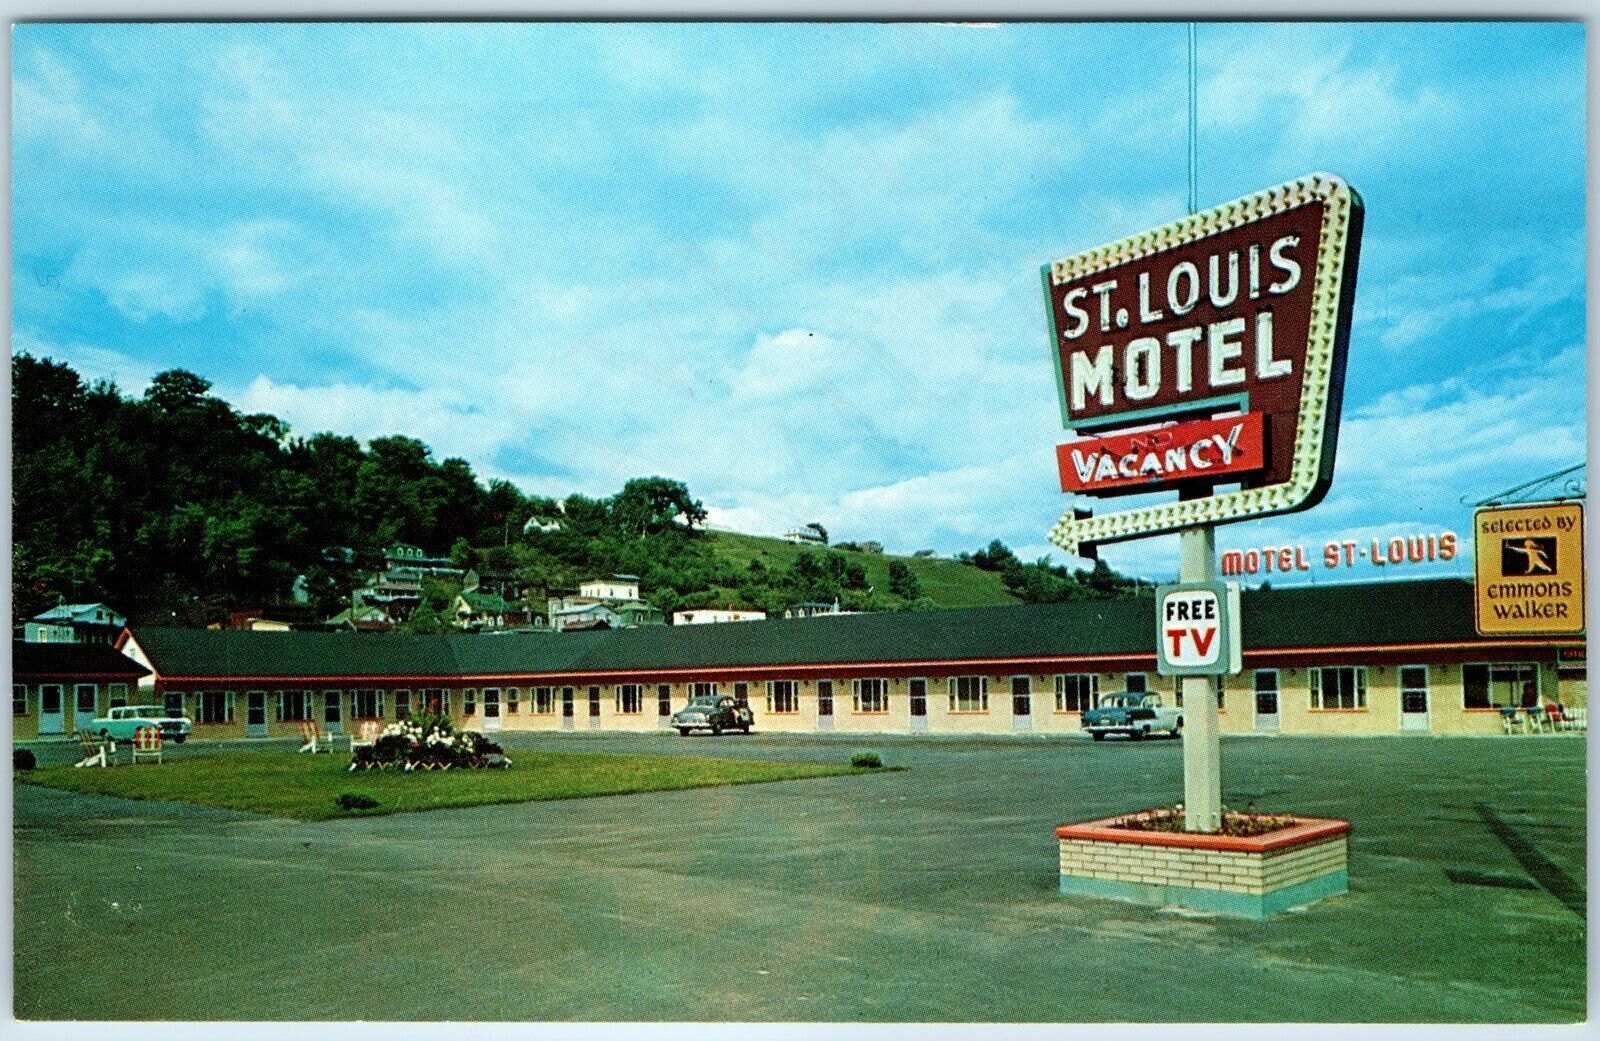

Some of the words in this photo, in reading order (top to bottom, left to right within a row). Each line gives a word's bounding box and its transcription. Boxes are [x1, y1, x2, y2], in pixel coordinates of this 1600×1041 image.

[1063, 279, 1129, 339] ST.
[1138, 235, 1302, 323] LOUIS
[1070, 311, 1293, 411] MOTEL
[1071, 423, 1244, 483] VACANCY
[1221, 545, 1309, 576] MOTEL
[1166, 599, 1215, 621] FREE
[1166, 627, 1216, 657] TV
